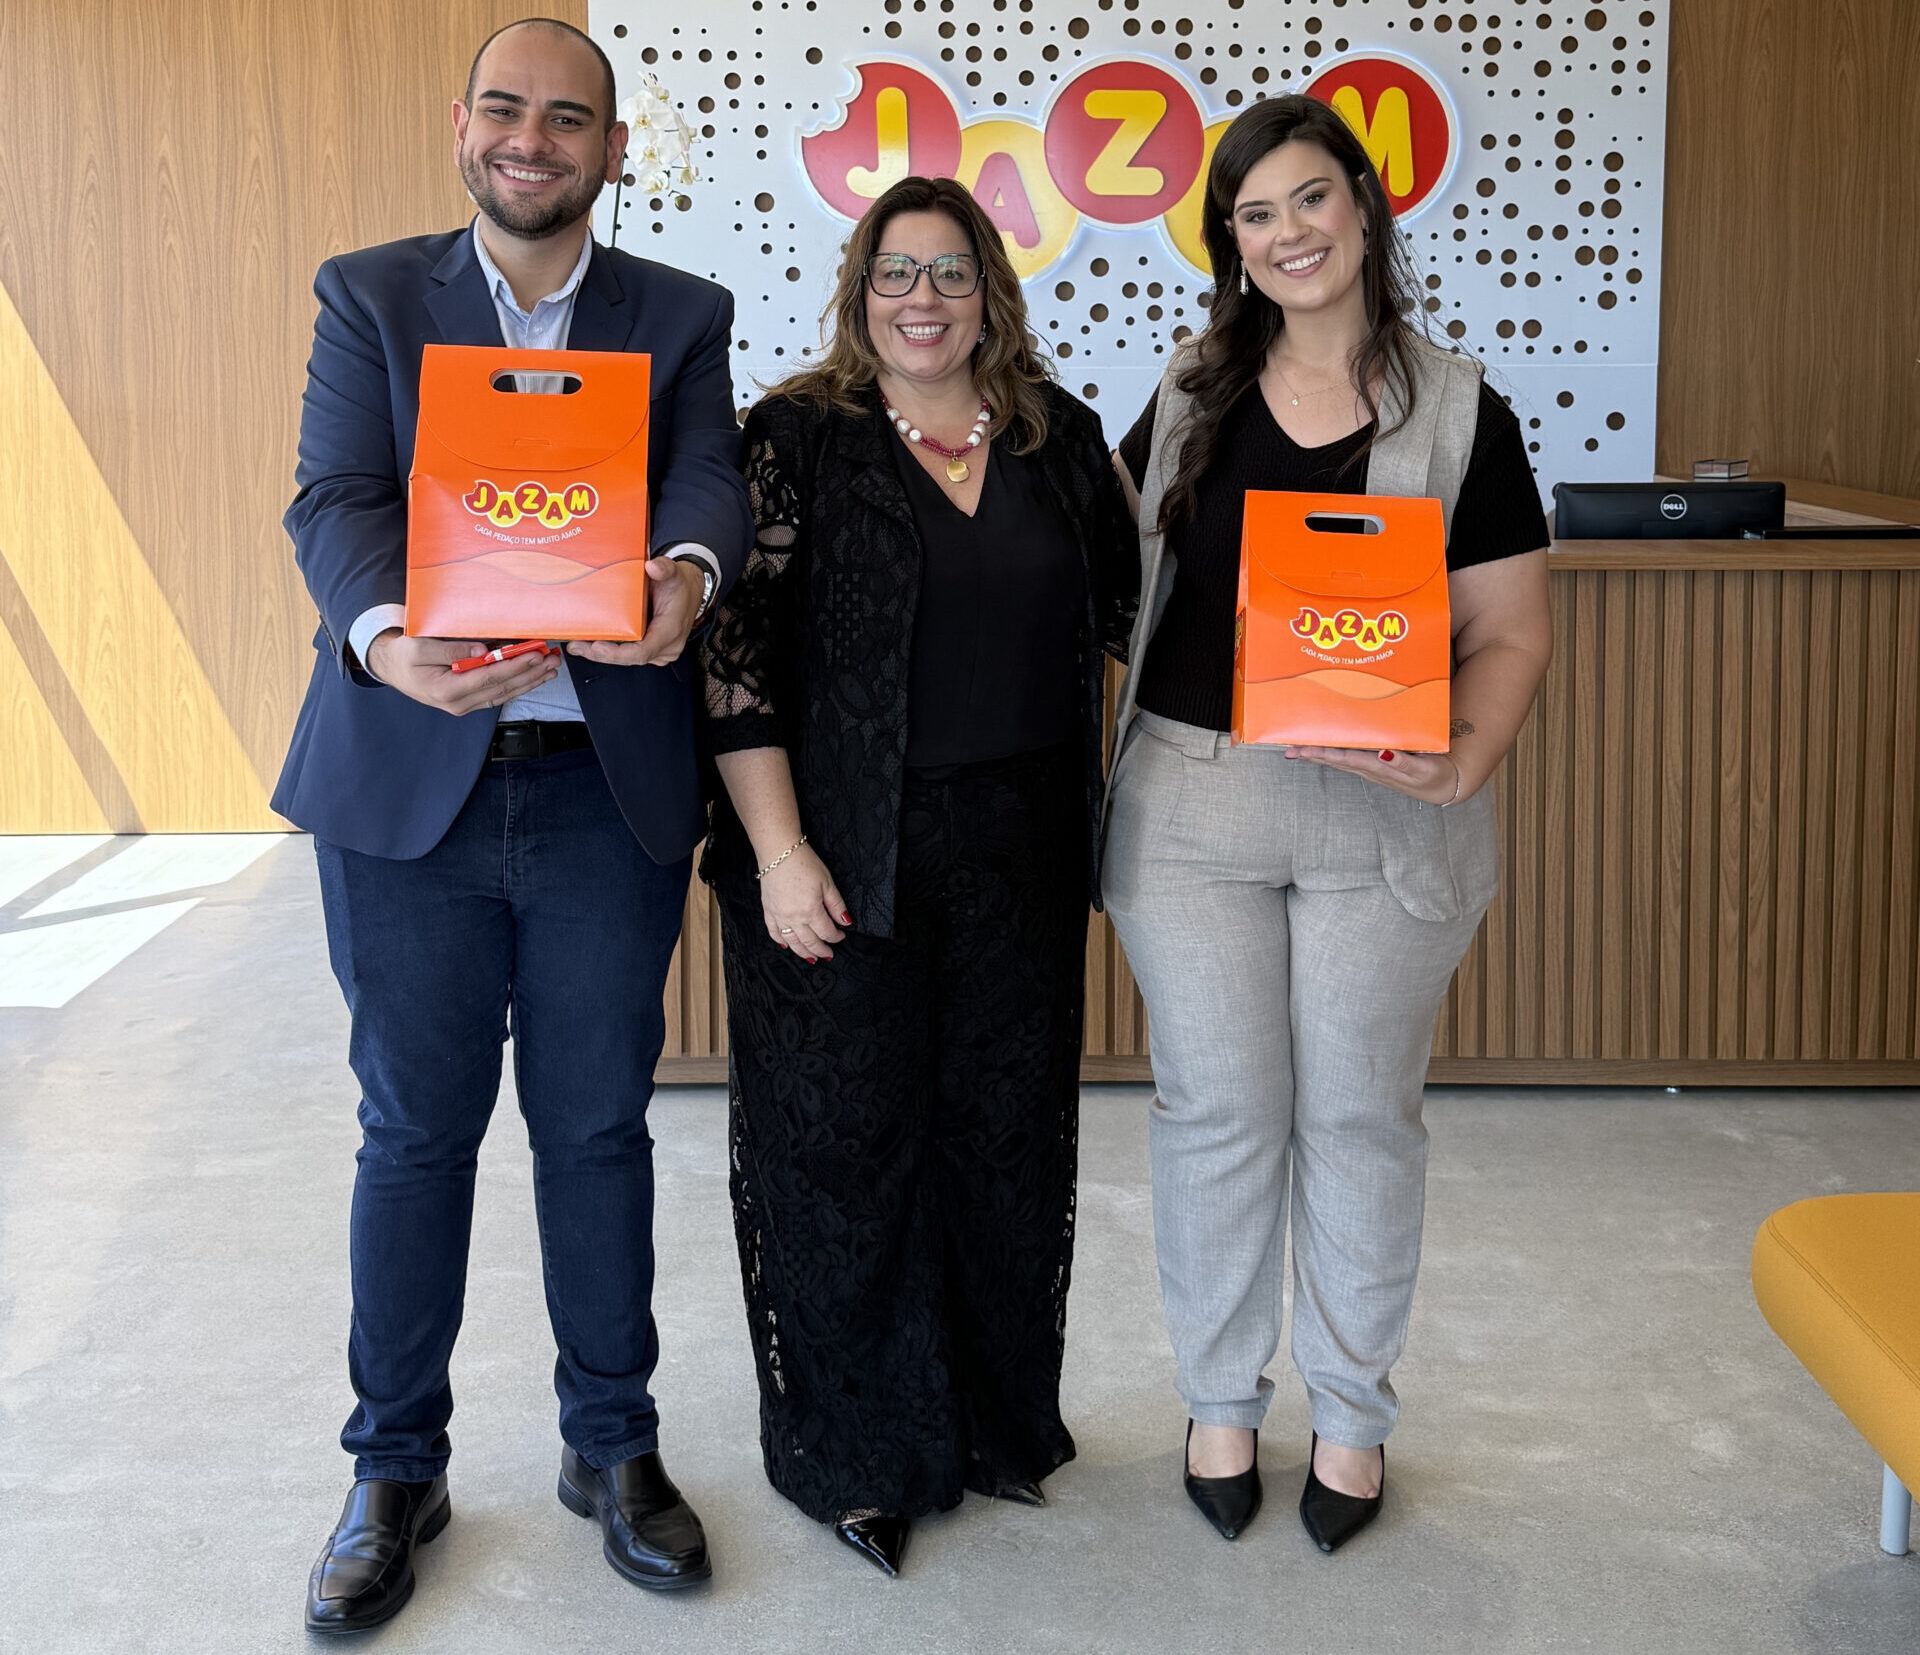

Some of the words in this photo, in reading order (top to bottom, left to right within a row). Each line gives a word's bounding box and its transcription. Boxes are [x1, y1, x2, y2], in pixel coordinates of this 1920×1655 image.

[845, 85, 1415, 249] JAZM
[473, 486, 590, 520] JAZAM
[474, 524, 493, 537] CADA
[493, 531, 520, 545] PEDAÇO
[521, 537, 536, 545] TEM
[537, 534, 560, 545] MUITO
[561, 527, 583, 540] AMOR
[1299, 612, 1401, 644] JAZAM
[1300, 645, 1316, 657] CADA
[1317, 653, 1340, 664] PEDAÇO
[1355, 656, 1375, 664] MUITO
[1376, 649, 1394, 661] AMOR
